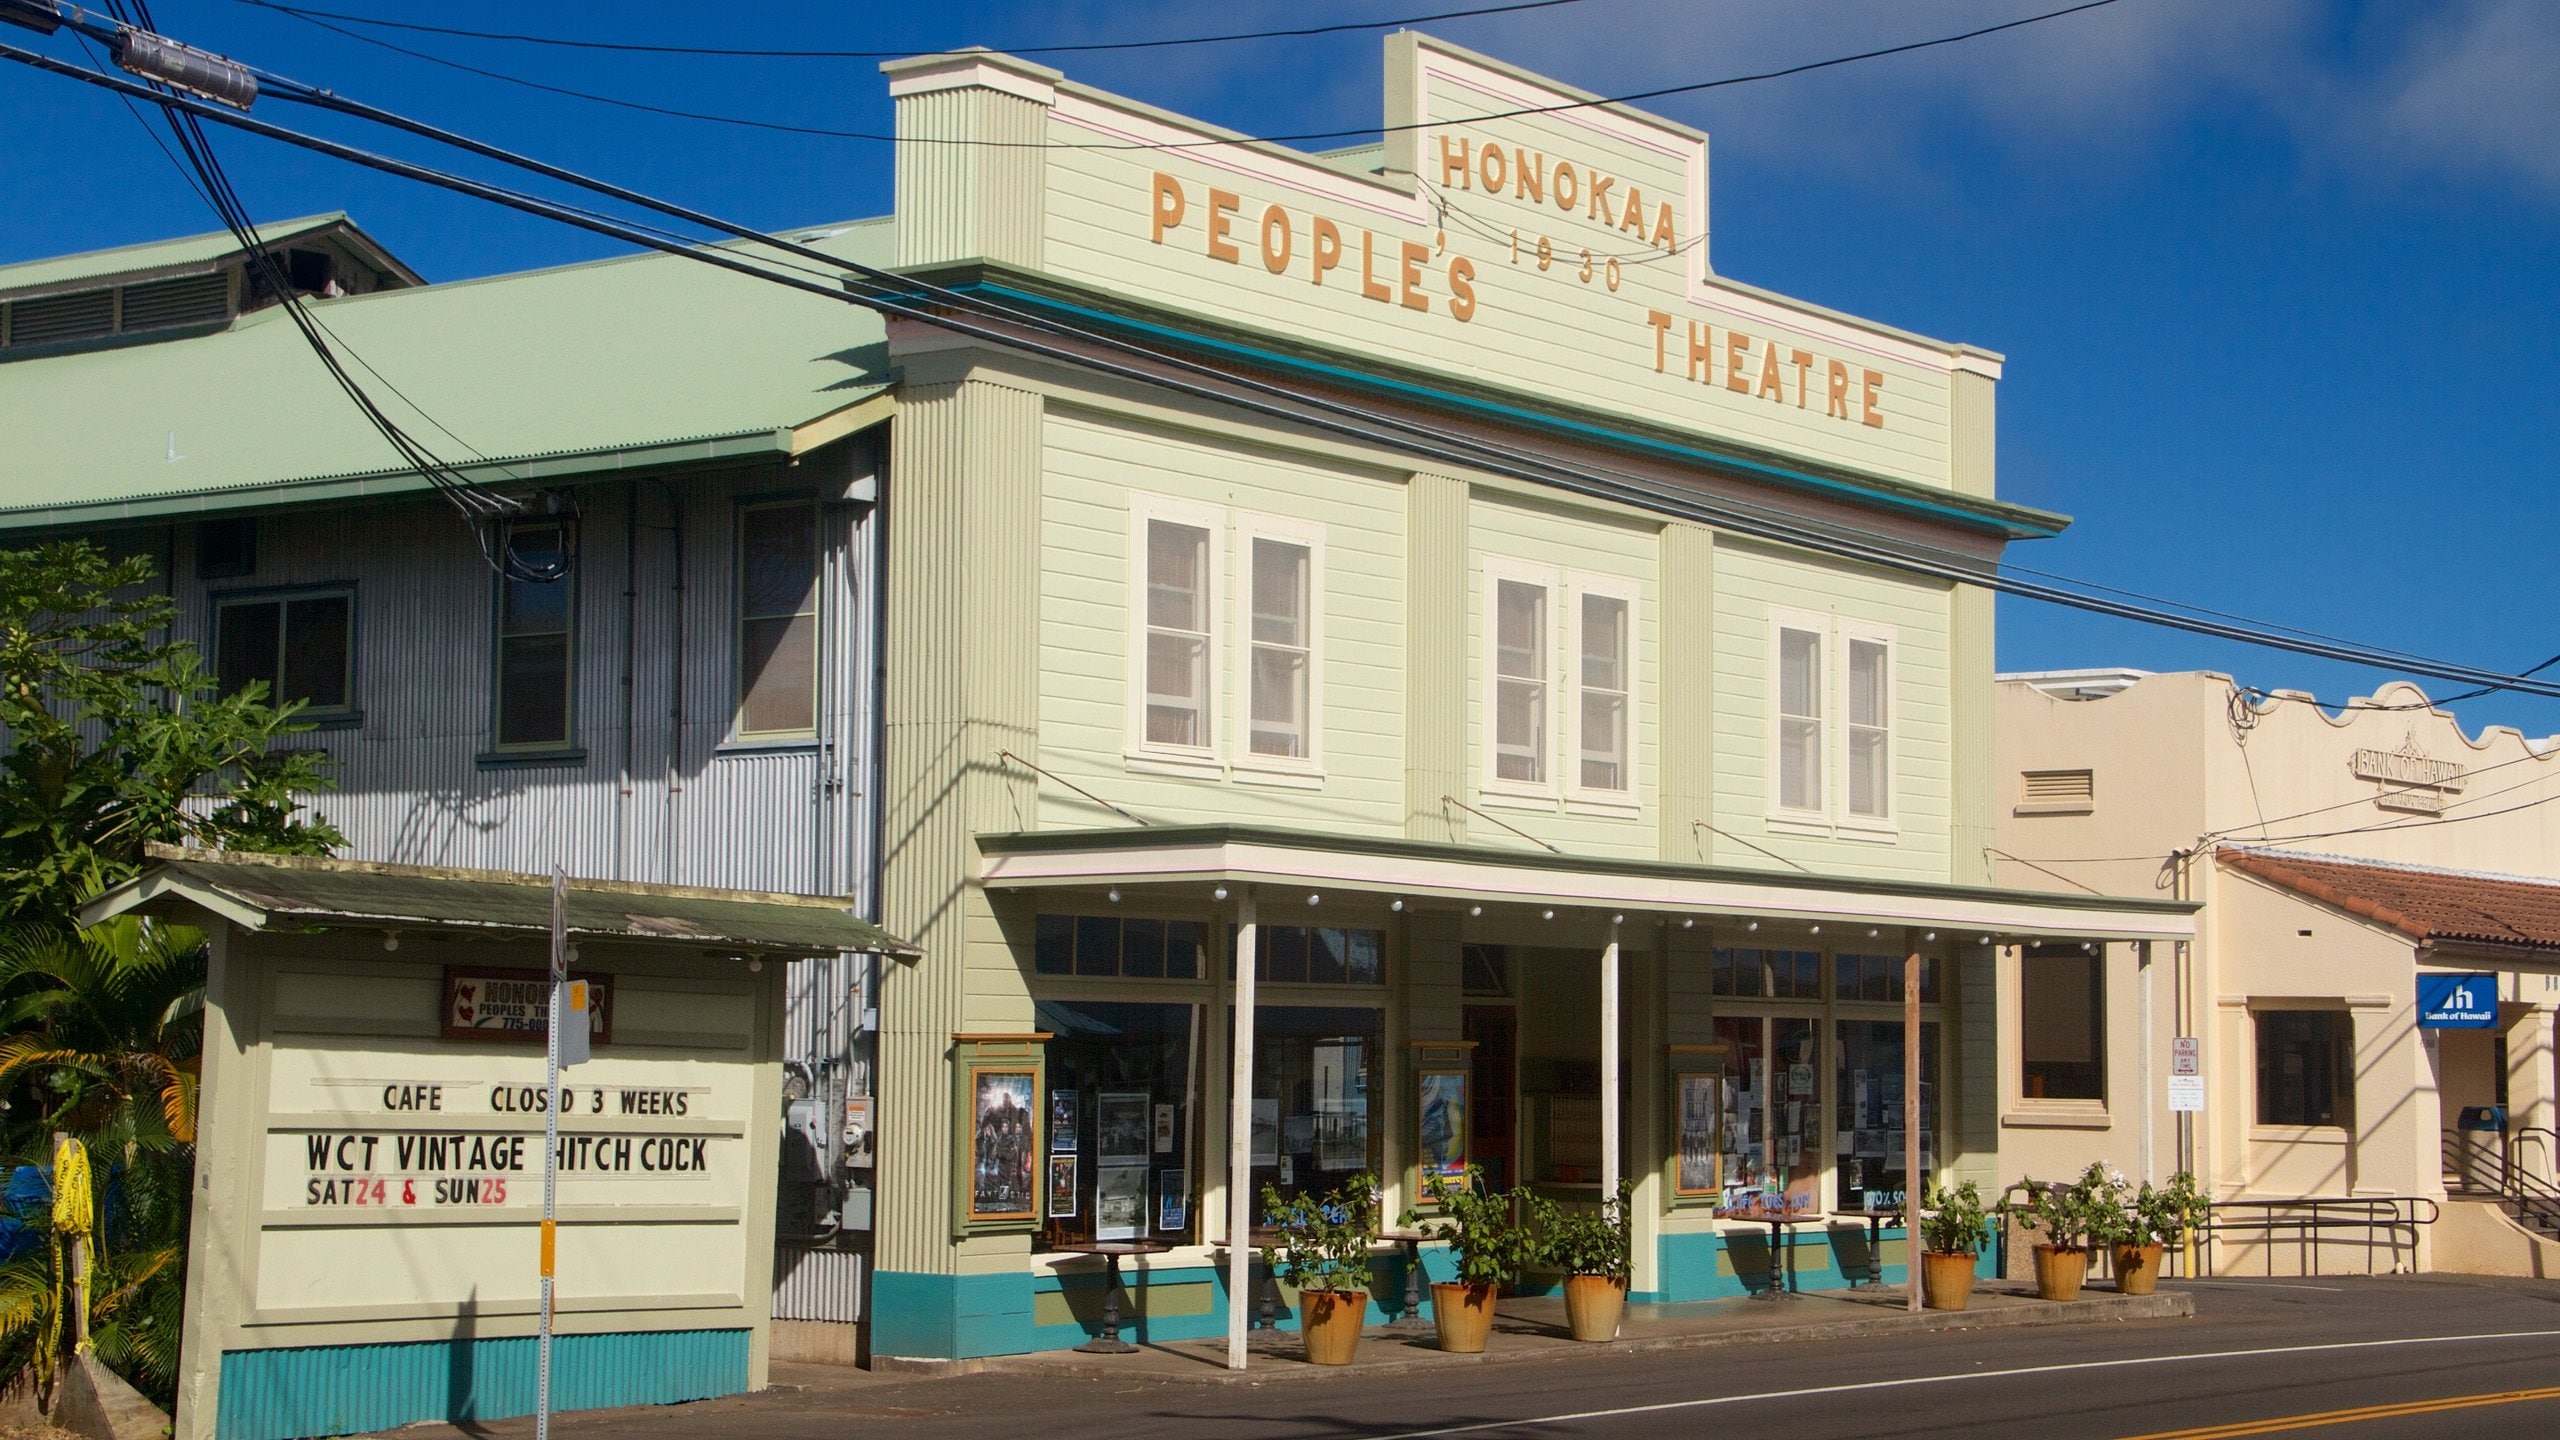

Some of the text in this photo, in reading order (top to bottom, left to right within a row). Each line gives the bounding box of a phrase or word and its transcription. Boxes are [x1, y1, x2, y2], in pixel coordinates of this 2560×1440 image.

[1440, 135, 1677, 255] HONOKAA
[1151, 171, 1476, 322] PEOPLE'S
[1647, 310, 1884, 427] THEATRE
[2361, 749, 2465, 788] BANK OF HAWAII
[485, 981, 550, 1004] HONOK
[479, 1003, 525, 1017] PEOPLES
[2425, 1011, 2491, 1020] Bank of Hawaii
[502, 1017, 550, 1031] 775-000
[2174, 1049, 2196, 1057] PARKING
[2180, 1041, 2191, 1049] NO
[384, 1085, 688, 1116] CAFE CLOSD 3 WEEKS
[308, 1135, 379, 1171] WCT
[398, 1135, 525, 1171] VINTAGE
[402, 1178, 416, 1205] &
